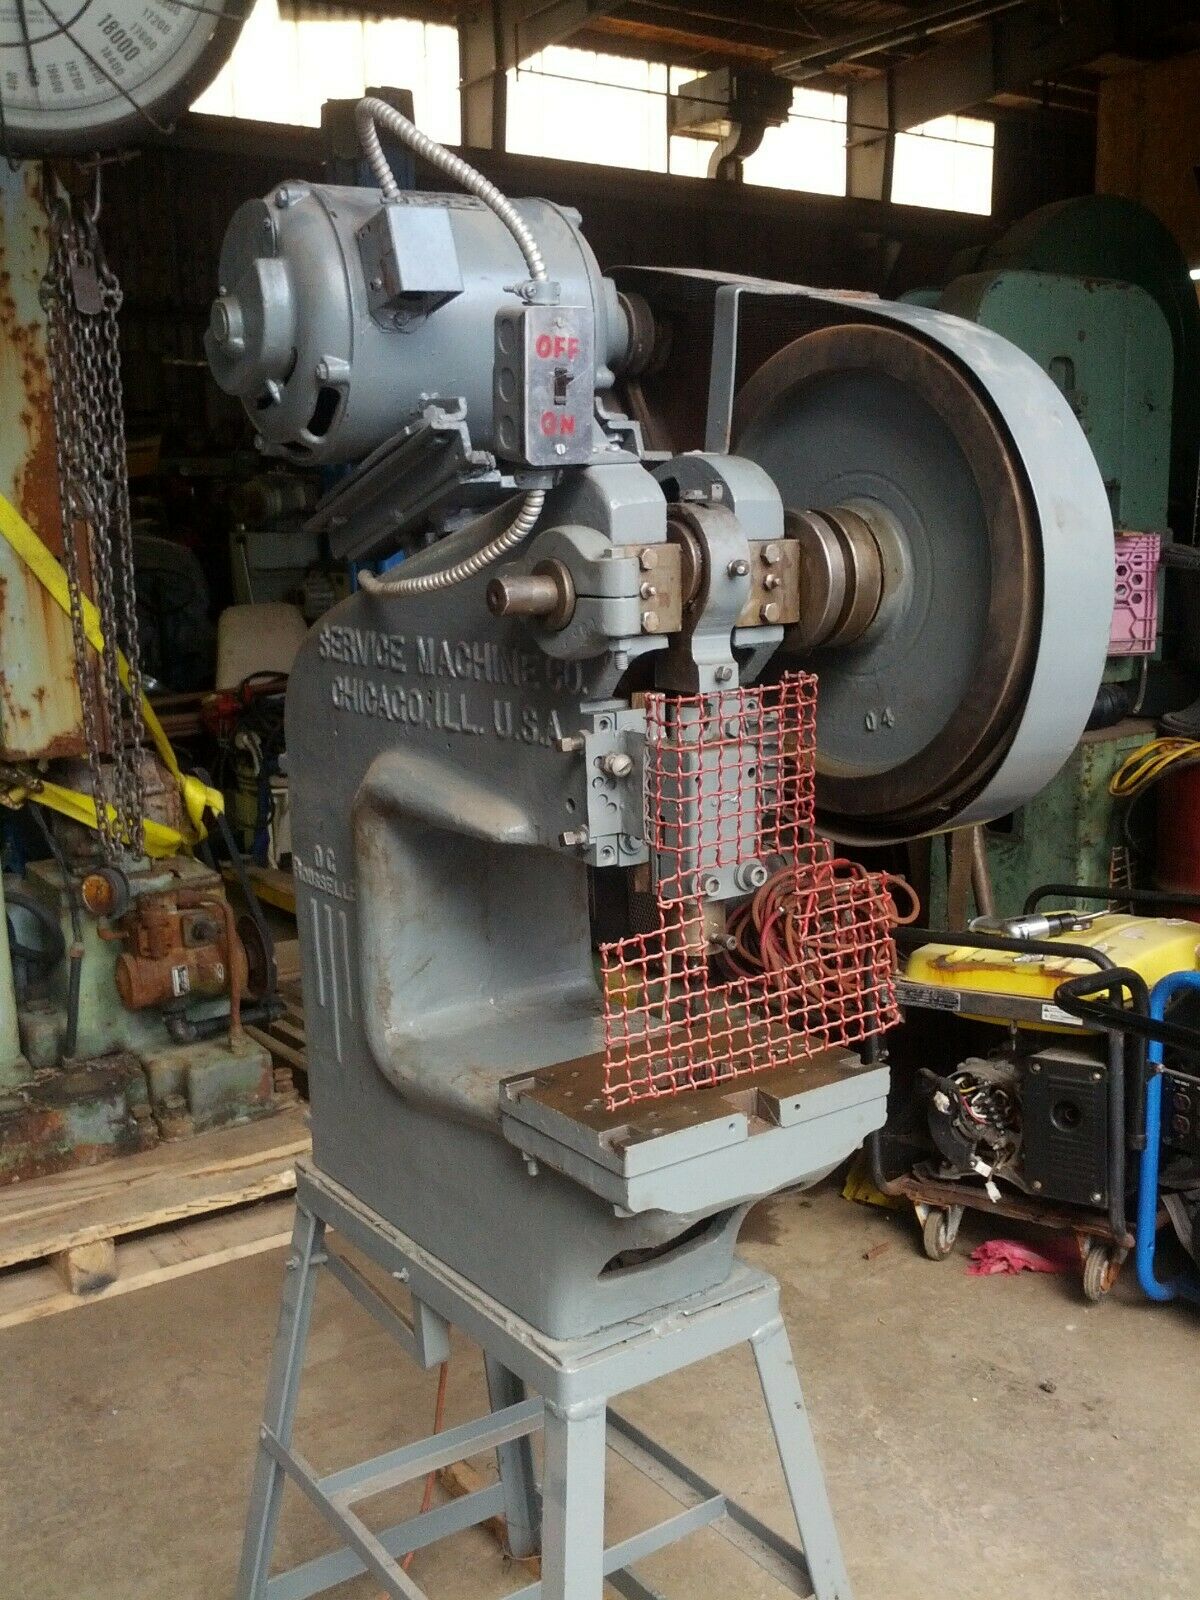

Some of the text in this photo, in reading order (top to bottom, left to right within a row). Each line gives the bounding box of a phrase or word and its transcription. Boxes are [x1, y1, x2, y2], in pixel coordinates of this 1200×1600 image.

[97, 13, 141, 61] 18000
[535, 335, 580, 360] OFF
[540, 411, 576, 436] ON
[319, 624, 407, 673] SERVICE
